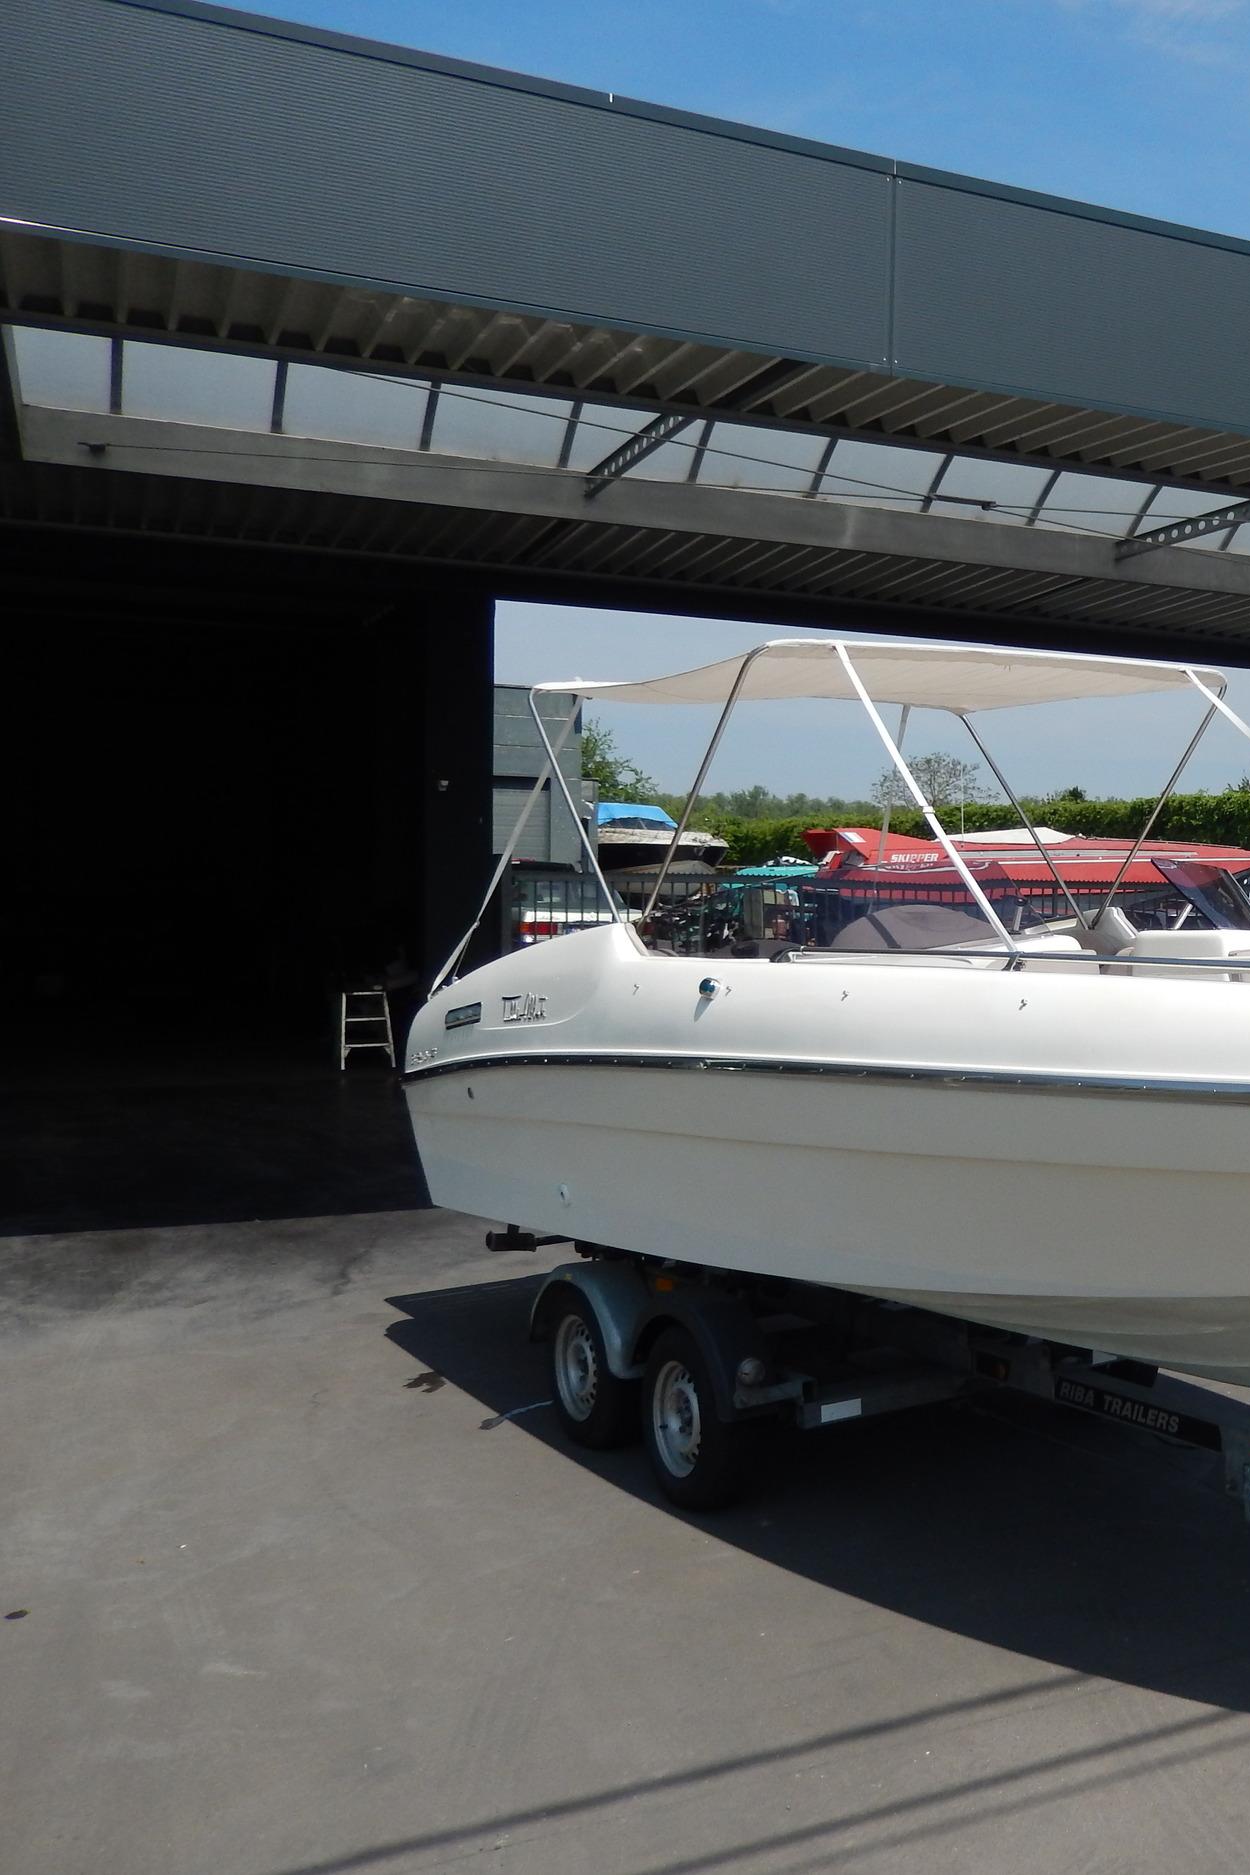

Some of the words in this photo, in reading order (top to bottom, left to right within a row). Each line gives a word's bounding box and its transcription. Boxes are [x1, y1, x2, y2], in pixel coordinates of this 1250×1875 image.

[891, 853, 938, 863] SKIPPER
[1060, 1381, 1096, 1407] RIBA
[1104, 1395, 1180, 1432] TRAILERS
